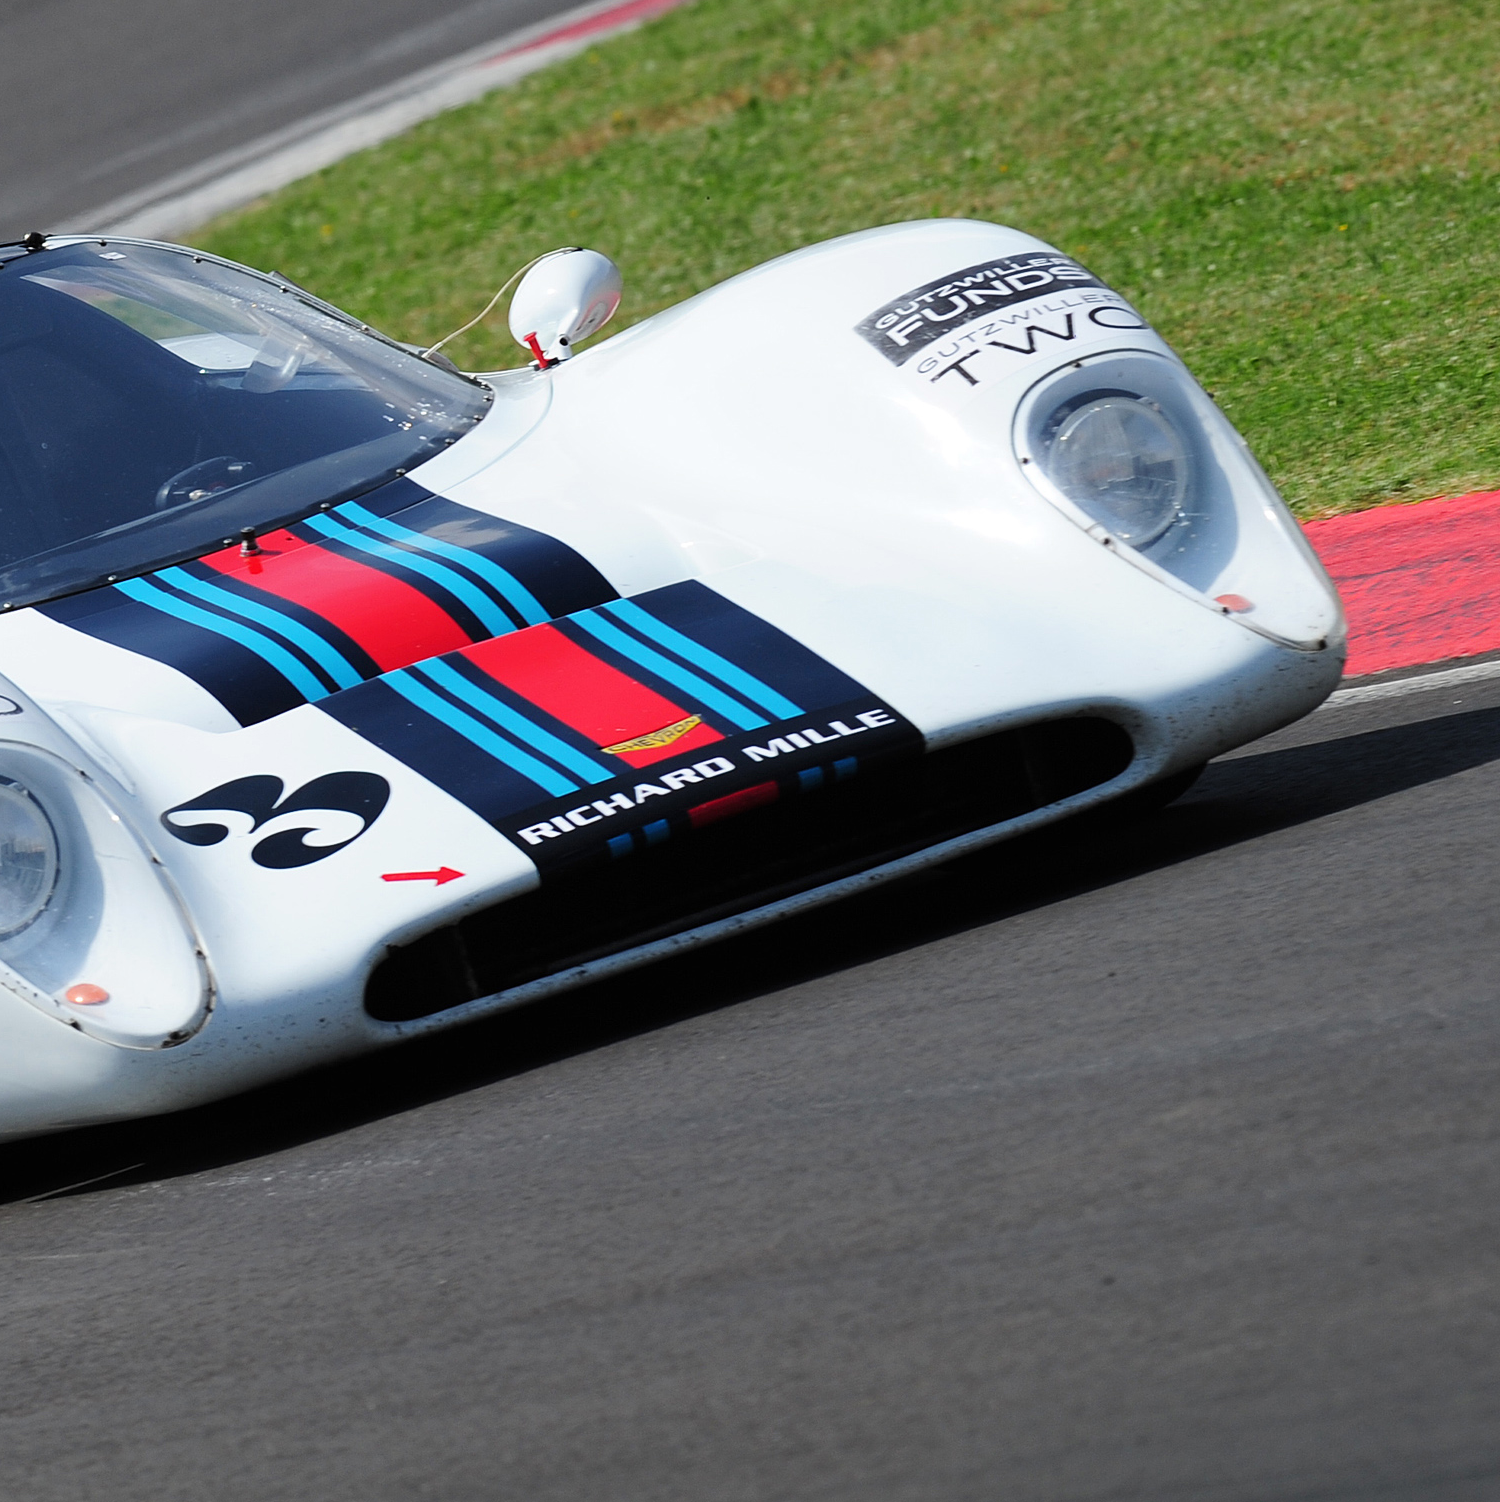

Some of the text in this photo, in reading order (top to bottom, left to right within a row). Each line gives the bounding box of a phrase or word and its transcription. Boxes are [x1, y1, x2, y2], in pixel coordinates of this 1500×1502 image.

[875, 256, 1076, 330] GUTZWILLER
[885, 265, 1092, 347] FUNDS
[917, 292, 1122, 374] GUTZWILLER
[930, 306, 1150, 386] TWO
[608, 717, 697, 752] CHEVRON
[517, 708, 897, 845] RICHARD MILLE
[159, 771, 391, 869] 3
